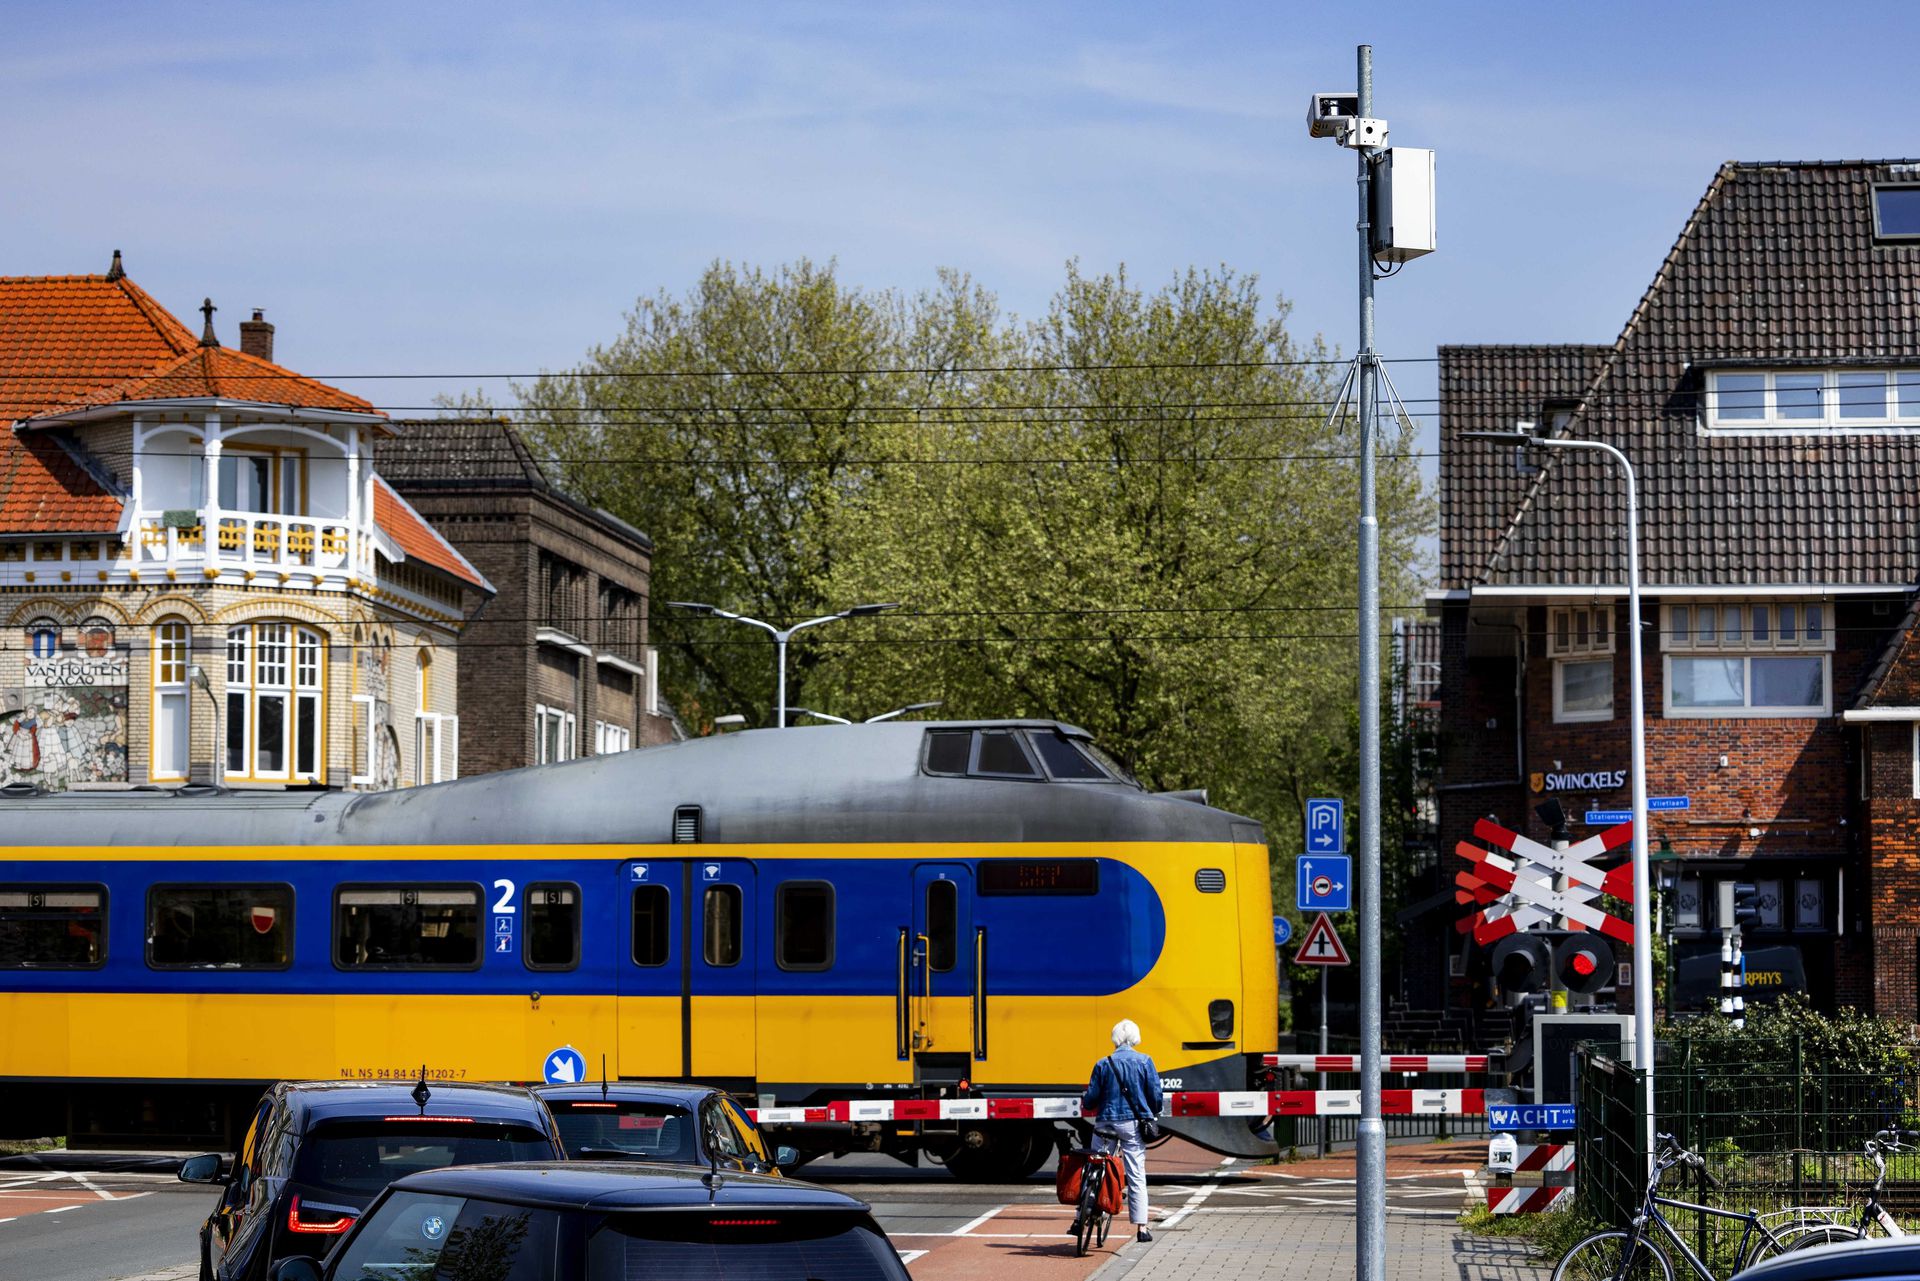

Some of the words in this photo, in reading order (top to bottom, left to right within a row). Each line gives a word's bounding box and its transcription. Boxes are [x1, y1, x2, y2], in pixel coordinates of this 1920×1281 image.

[26, 666, 56, 676] VAN
[60, 664, 122, 676] HOUTEN
[45, 676, 95, 686] CACAO
[1318, 812, 1331, 830] P
[1589, 813, 1632, 821] Stationsweg
[492, 878, 516, 914] 2
[1735, 971, 1782, 987] RPHY'S
[340, 1068, 355, 1077] NL
[358, 1068, 373, 1077] NS
[377, 1068, 390, 1078] 94
[393, 1068, 406, 1078] 84
[1491, 1109, 1560, 1125] WACHT
